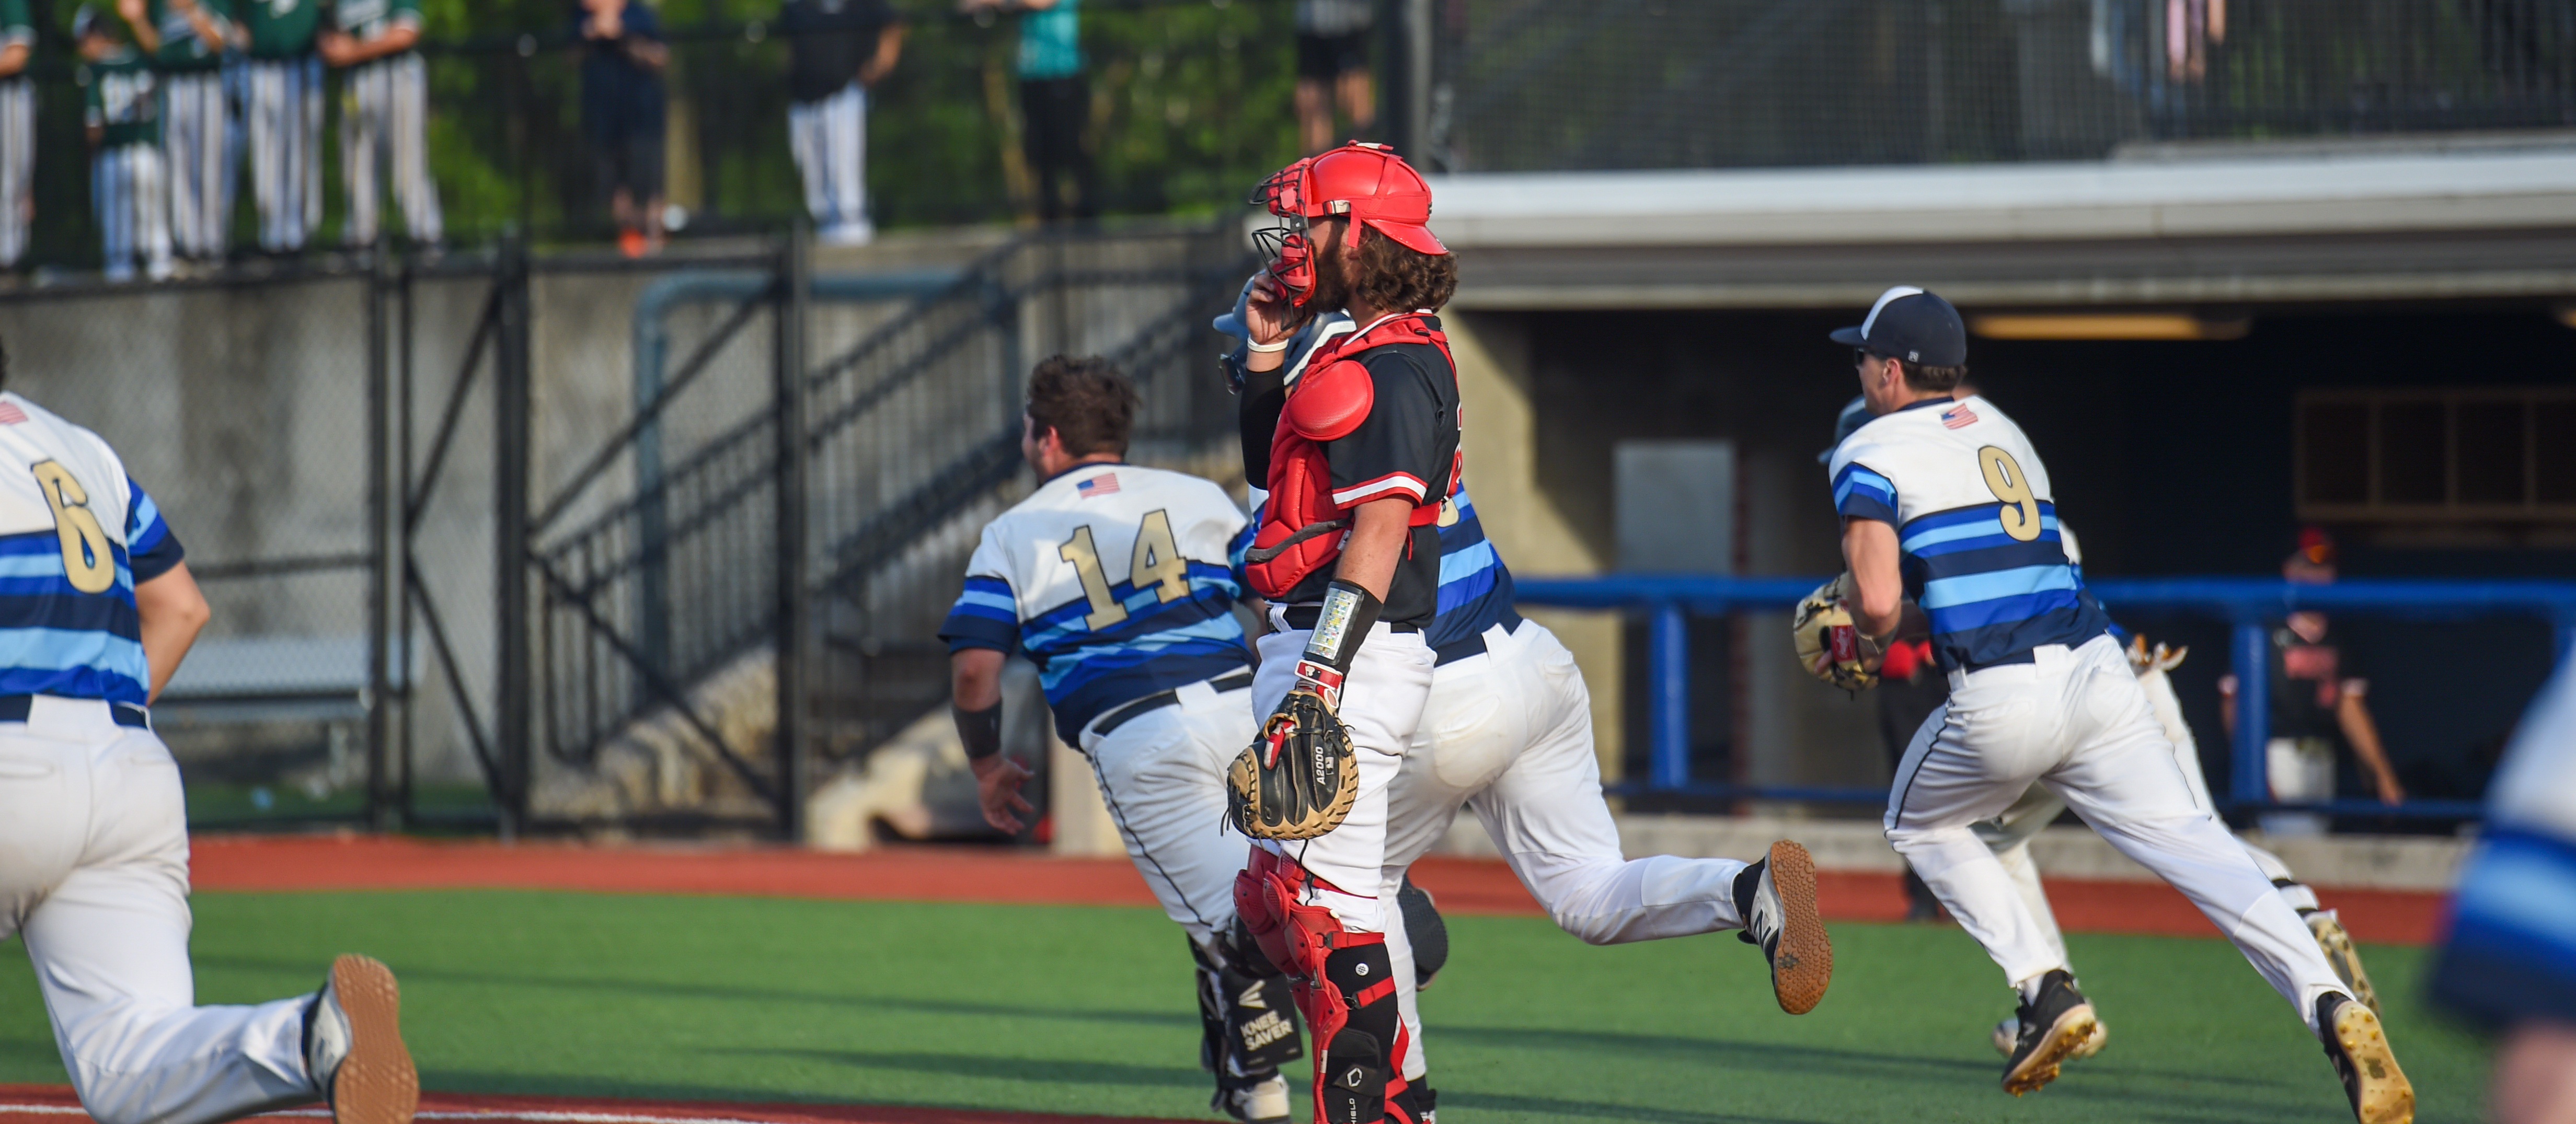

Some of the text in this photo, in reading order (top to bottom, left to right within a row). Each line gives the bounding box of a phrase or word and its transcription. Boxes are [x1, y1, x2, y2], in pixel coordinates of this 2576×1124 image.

[30, 457, 115, 594] 6
[1977, 445, 2042, 542] 9
[1057, 508, 1191, 632] 14
[1315, 746, 1326, 785] A2000
[1239, 1009, 1280, 1038] KNEE
[1245, 1018, 1293, 1051] SAVER
